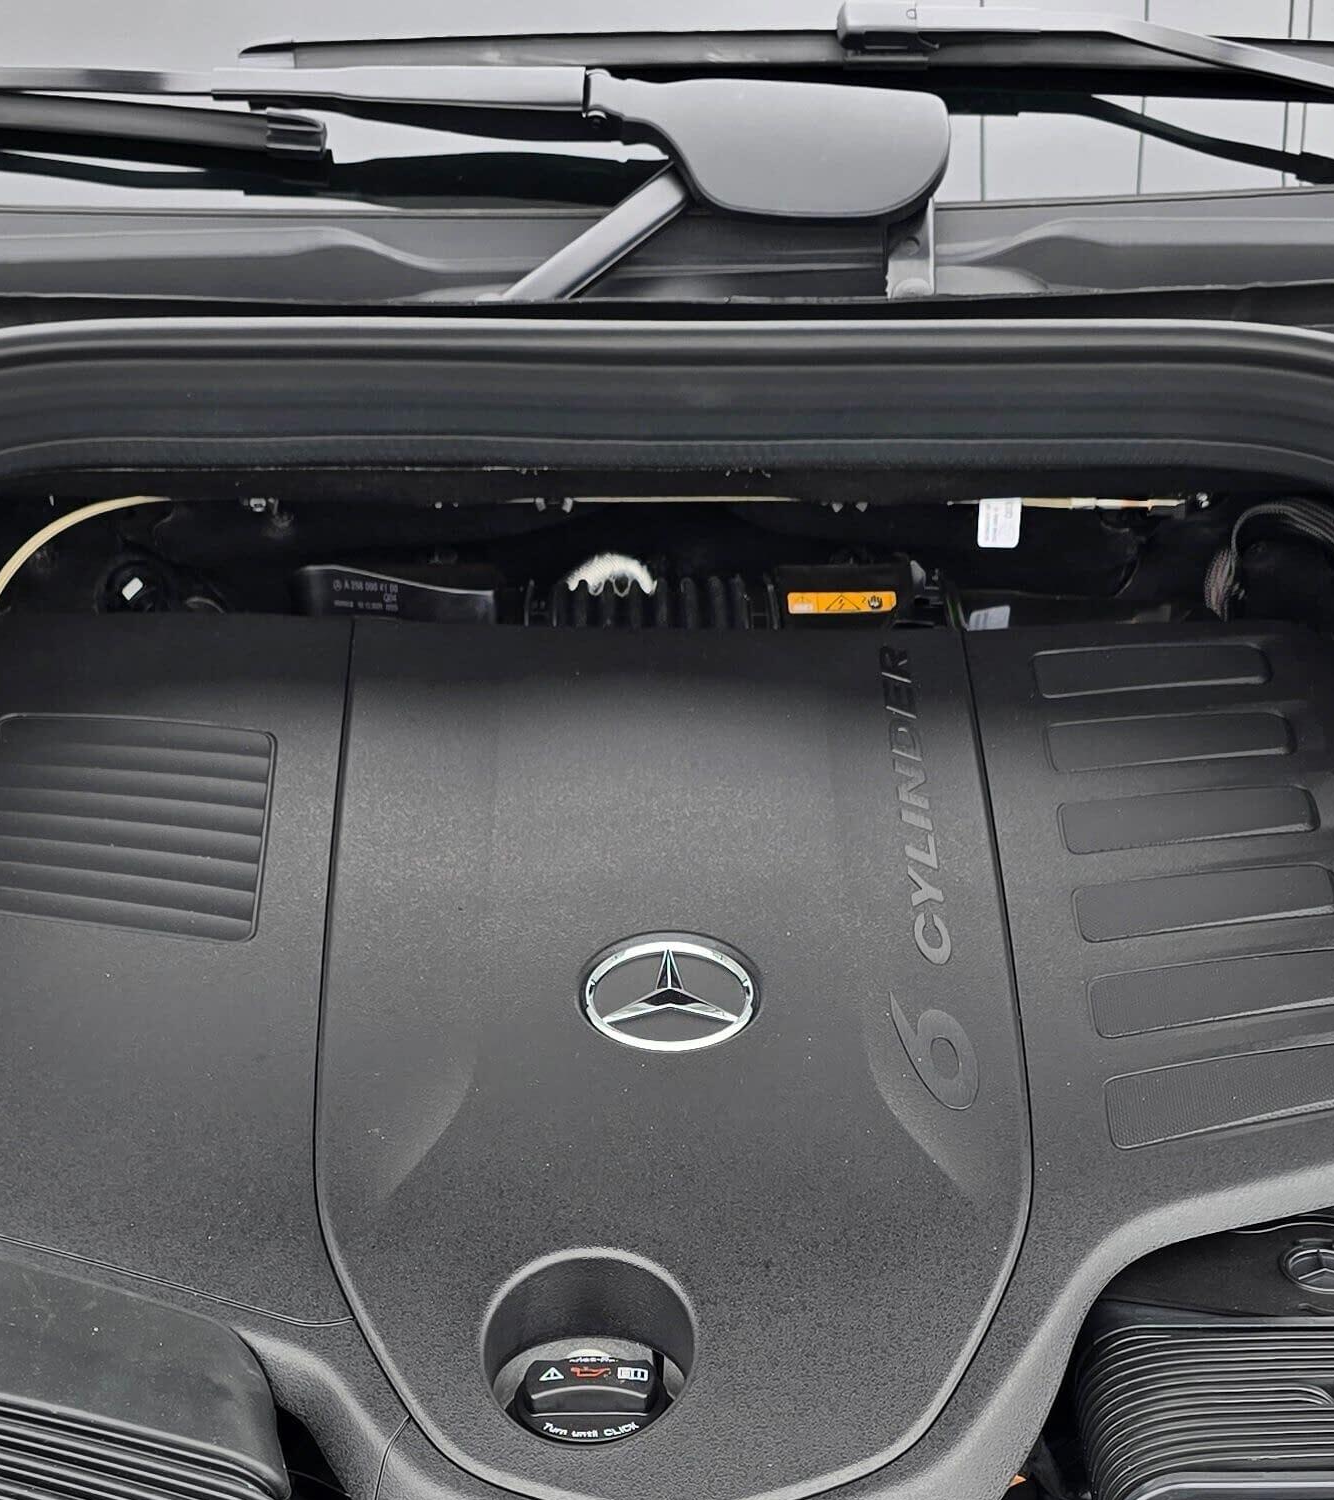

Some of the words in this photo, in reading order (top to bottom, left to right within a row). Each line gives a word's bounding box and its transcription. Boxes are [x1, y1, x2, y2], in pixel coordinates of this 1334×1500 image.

[879, 644, 953, 967] CYLINDER
[888, 991, 979, 1111] 6
[543, 1422, 568, 1435] Turn
[571, 1430, 598, 1438] until
[603, 1421, 640, 1437] CLICK
